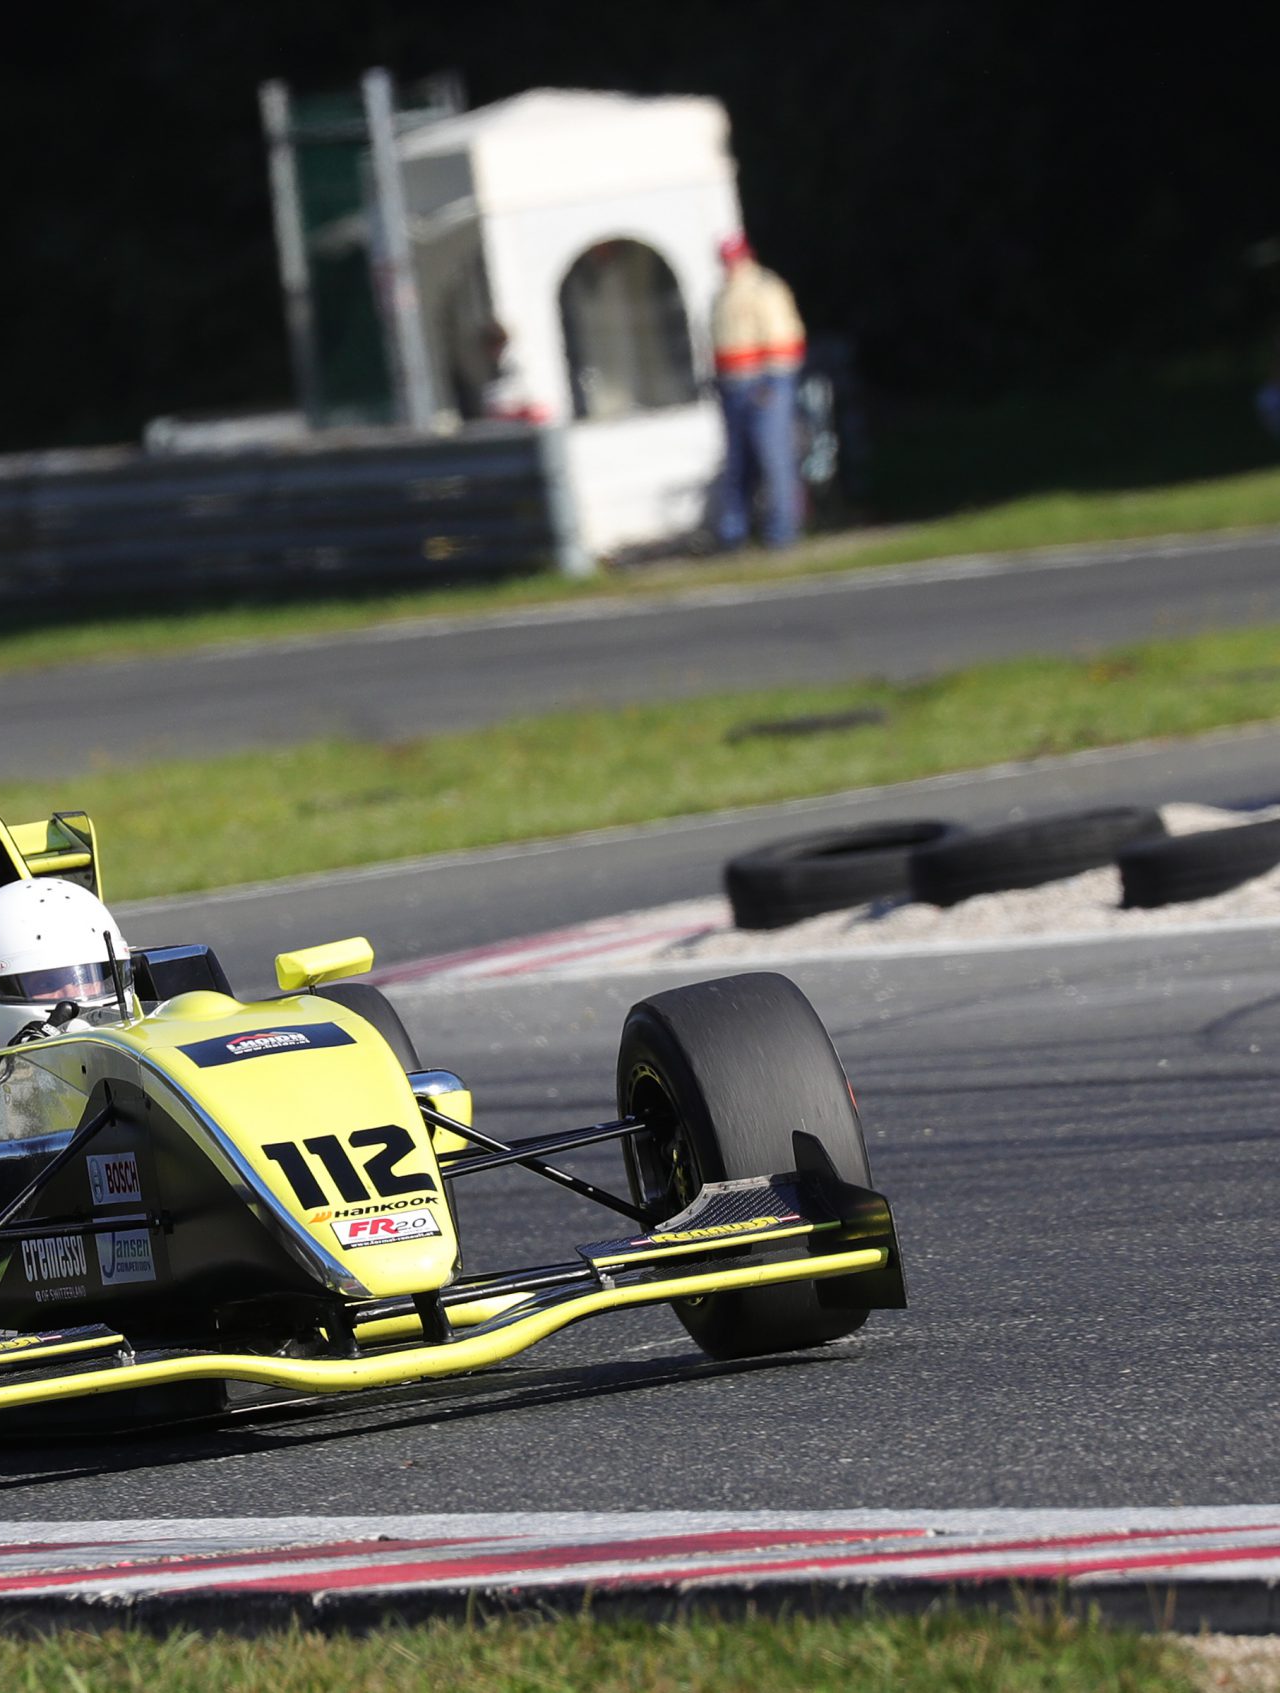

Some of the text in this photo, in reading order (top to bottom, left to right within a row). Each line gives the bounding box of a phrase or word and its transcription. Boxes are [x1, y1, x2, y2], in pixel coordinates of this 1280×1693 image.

[104, 1160, 140, 1194] BOSCH
[261, 1124, 438, 1211] 112
[21, 1235, 88, 1282] cremesso
